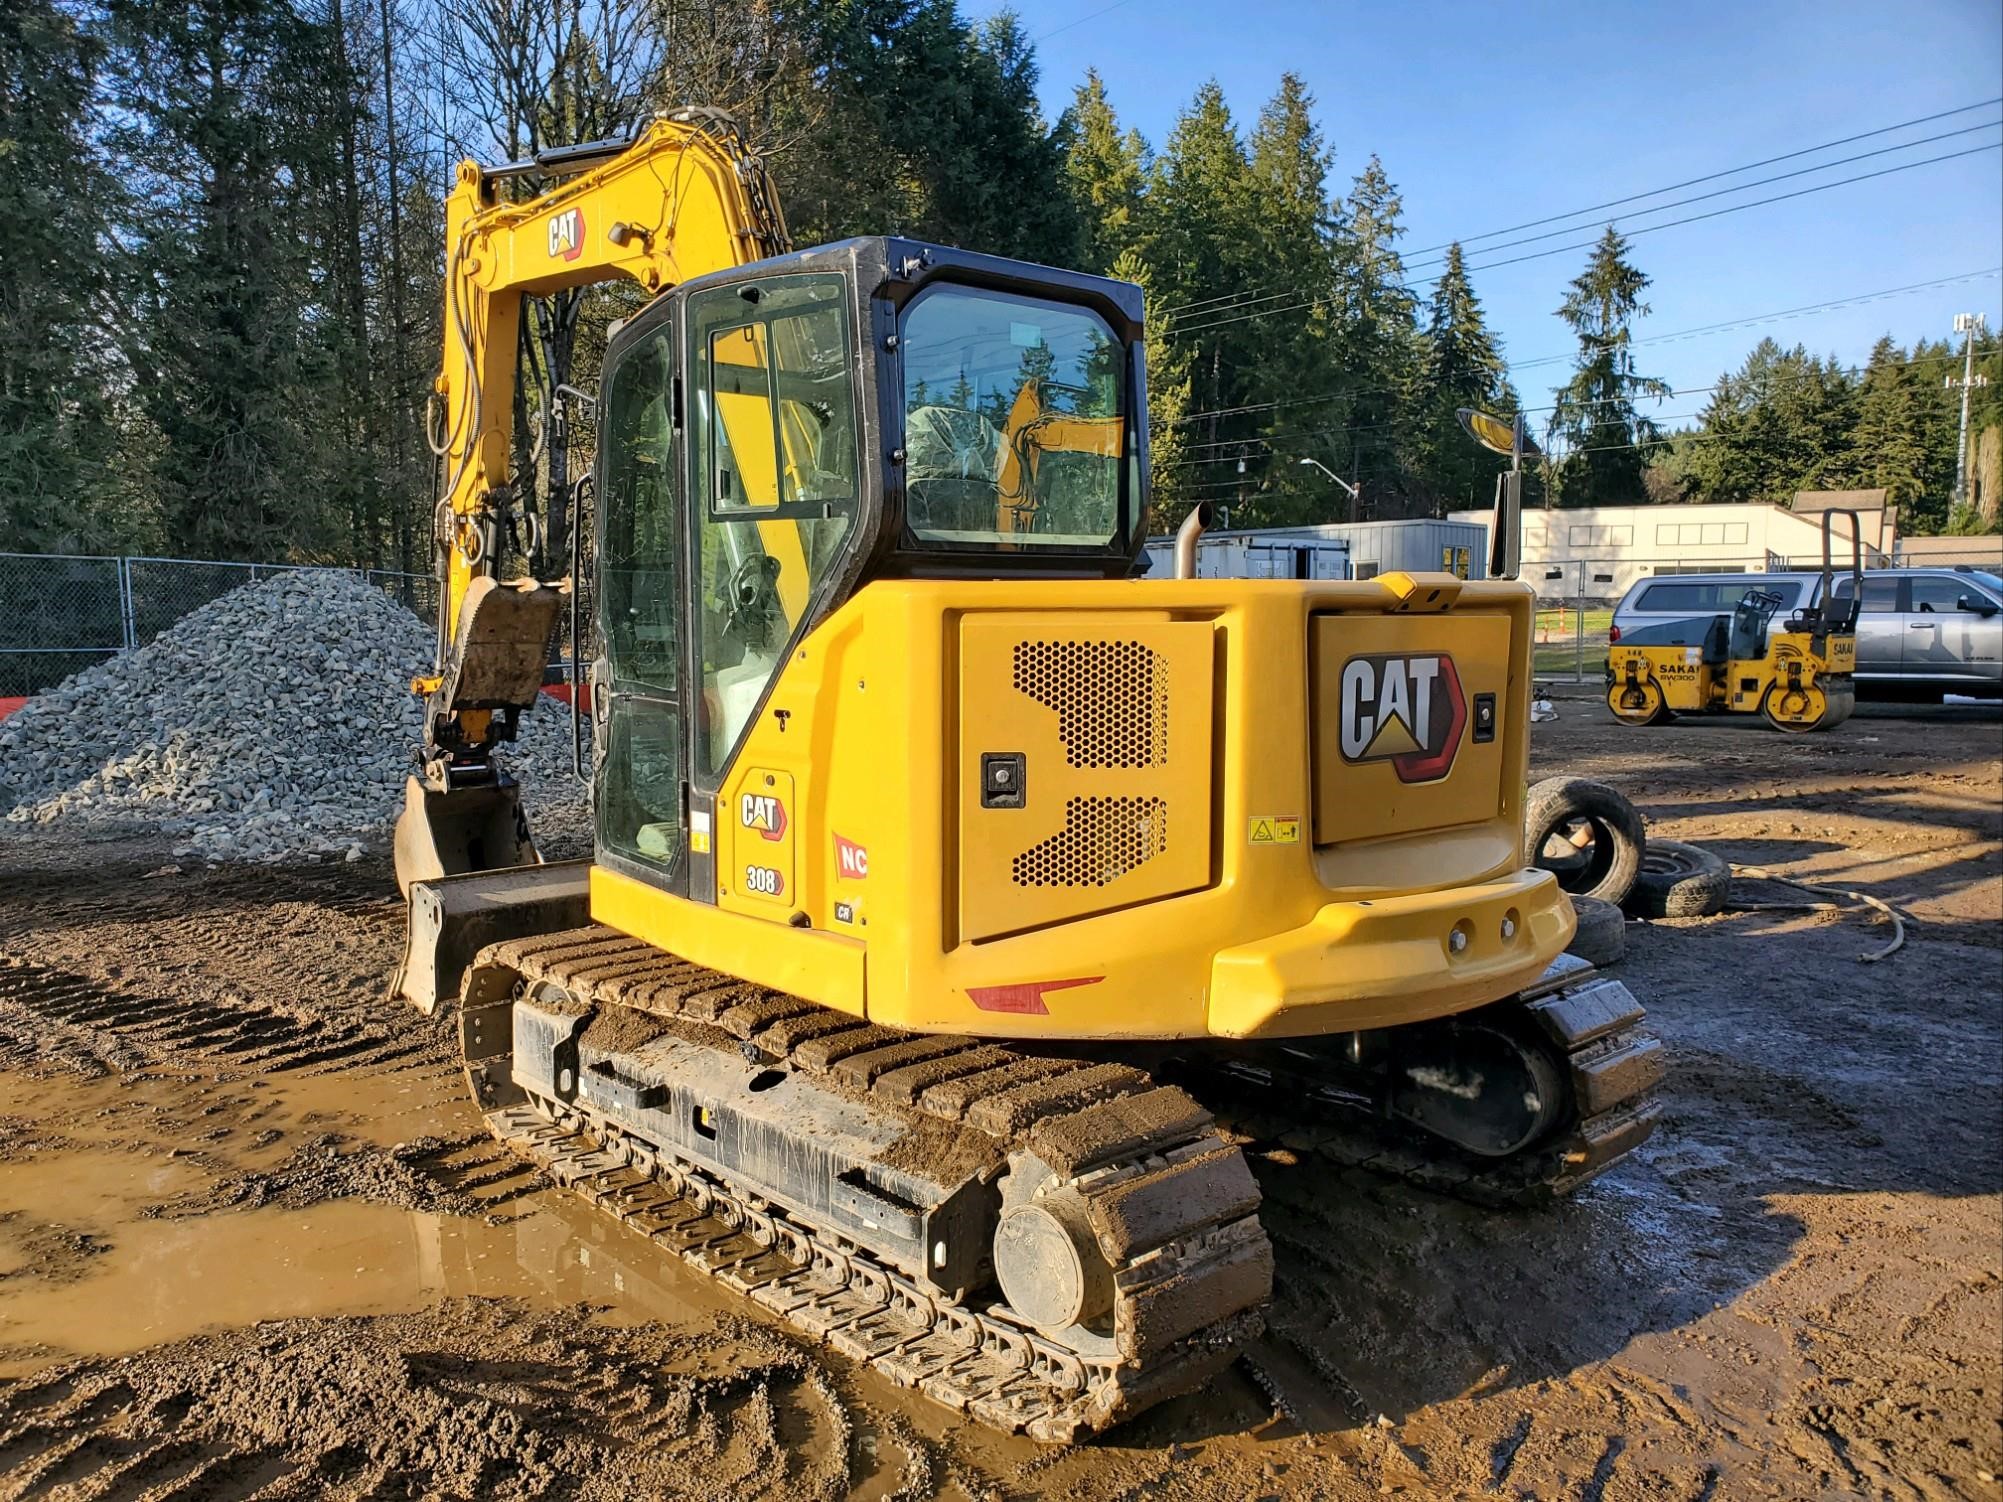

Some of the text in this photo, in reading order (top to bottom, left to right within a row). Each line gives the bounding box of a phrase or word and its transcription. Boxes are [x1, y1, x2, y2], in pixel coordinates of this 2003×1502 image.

[548, 209, 577, 257] CAT
[1659, 664, 1700, 674] SAKAI
[1341, 657, 1440, 759] CAT
[742, 794, 776, 831] CAT
[841, 845, 867, 874] NC
[747, 866, 776, 894] 308
